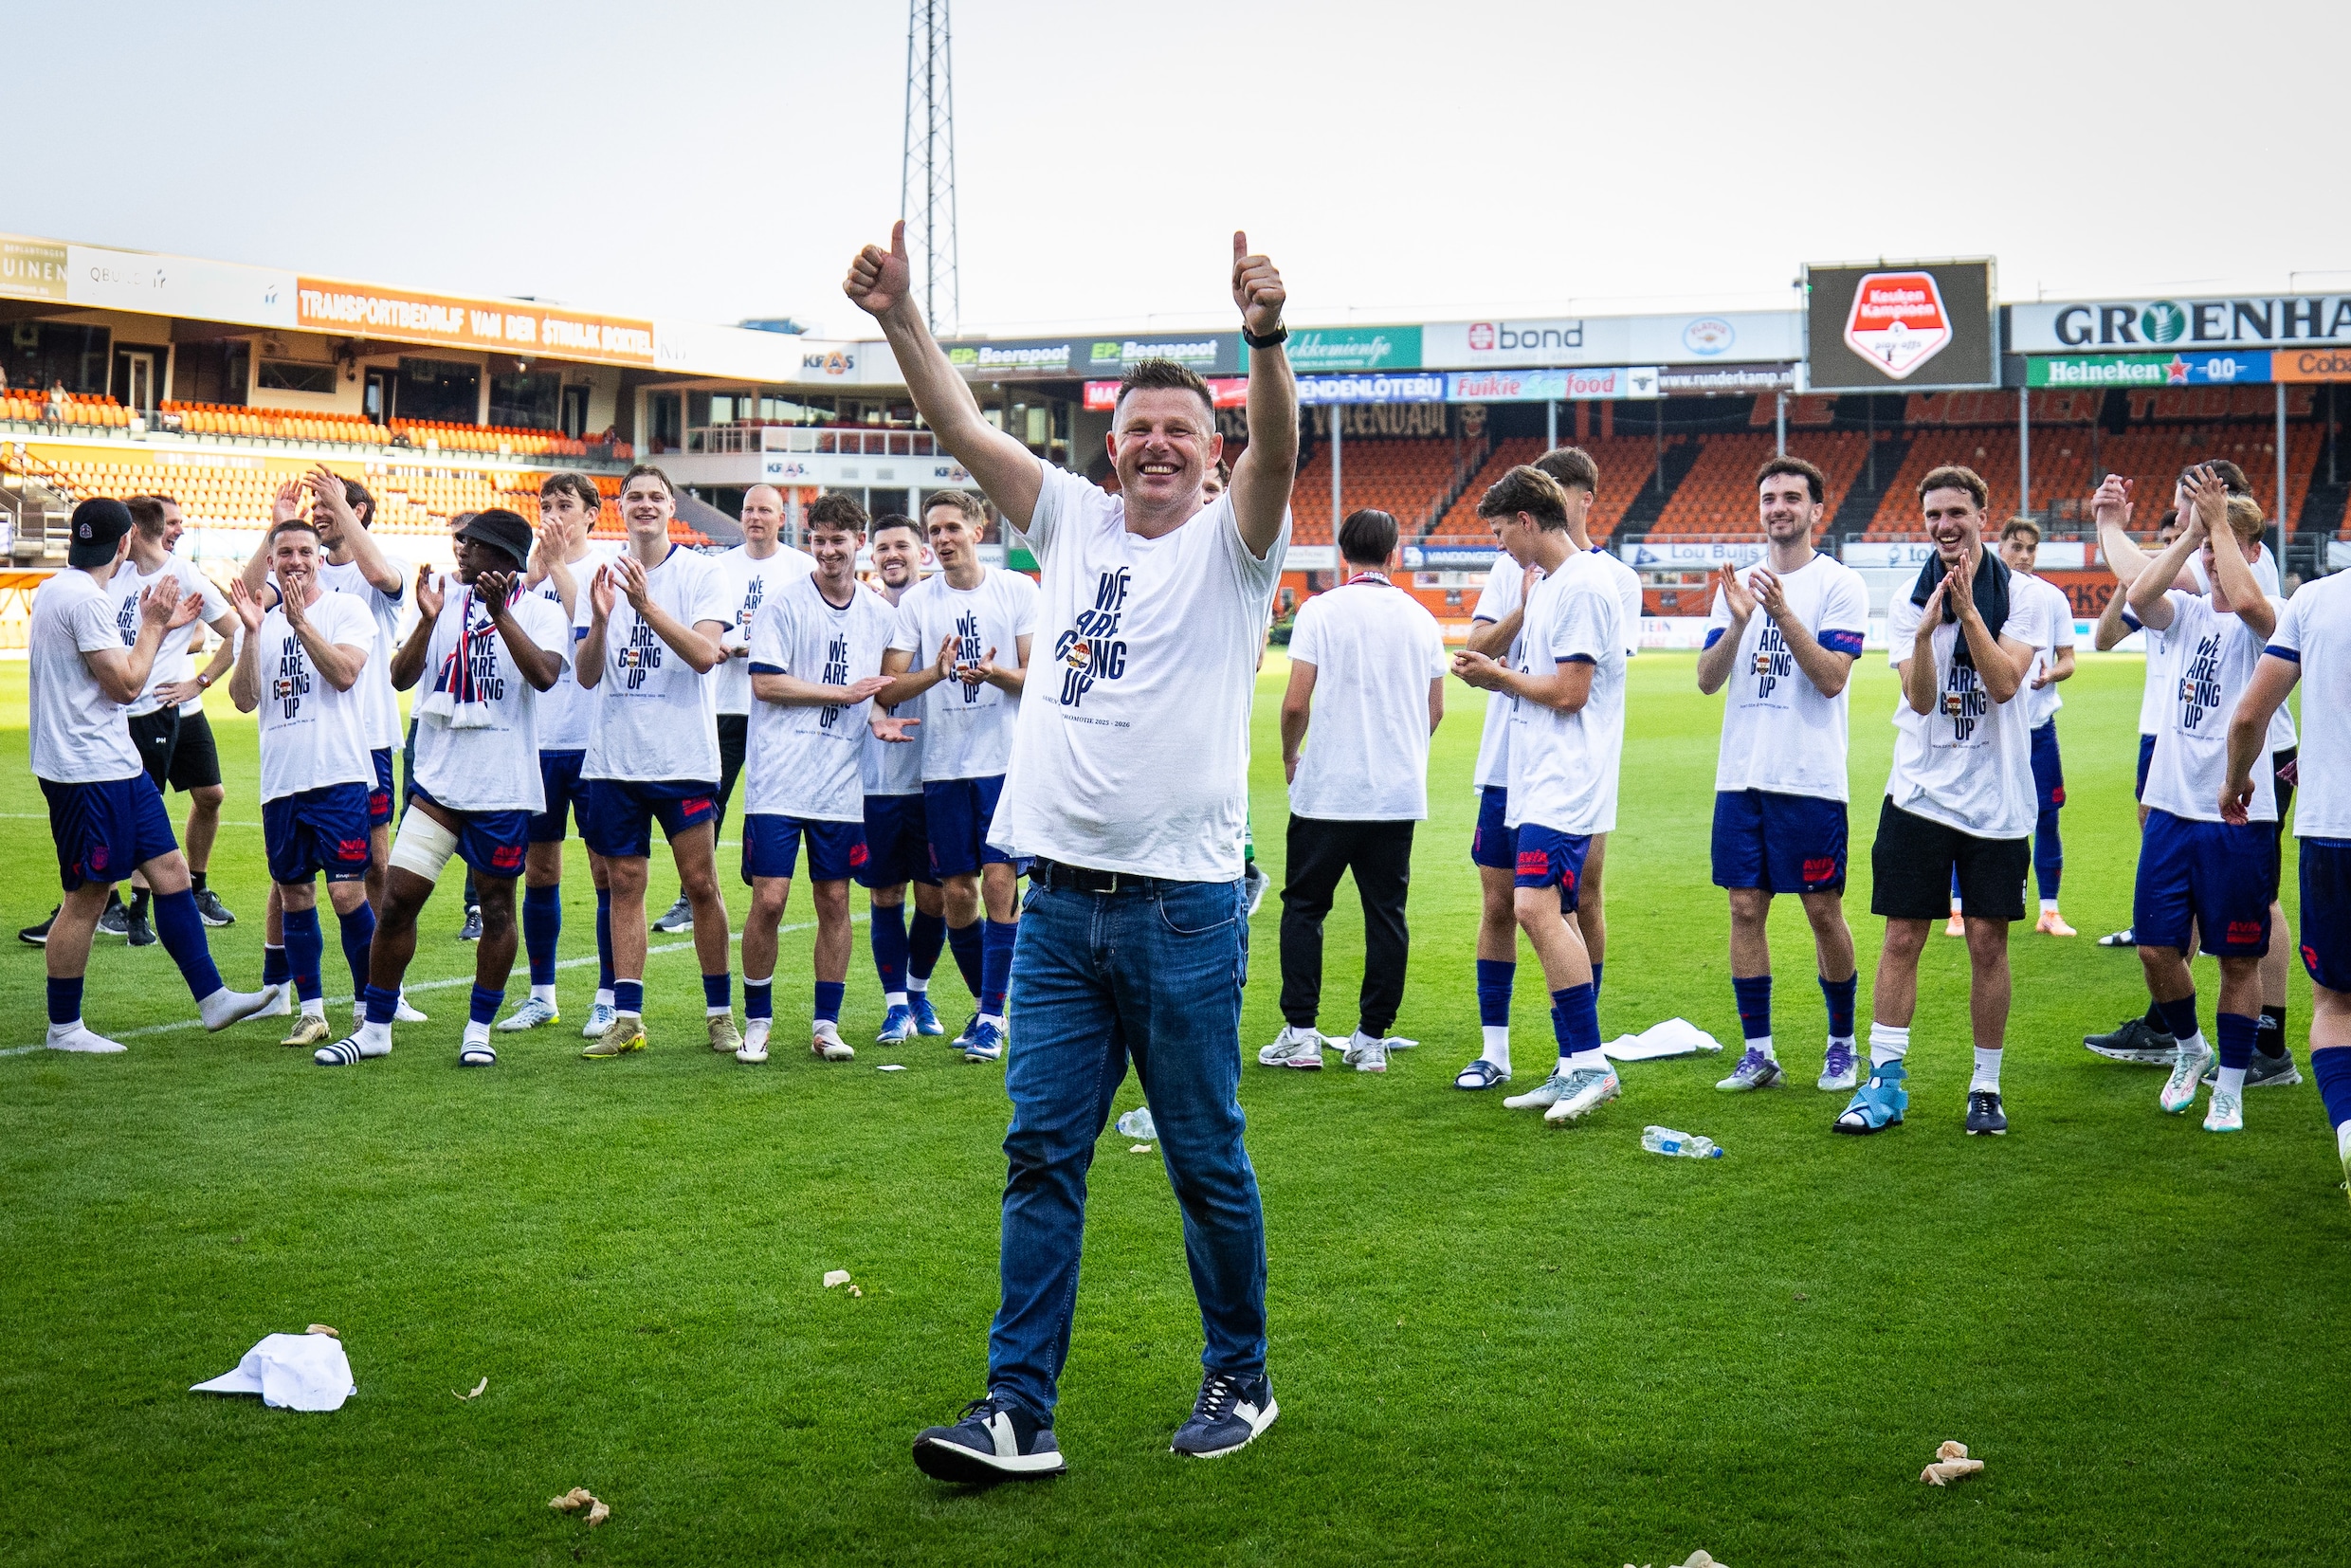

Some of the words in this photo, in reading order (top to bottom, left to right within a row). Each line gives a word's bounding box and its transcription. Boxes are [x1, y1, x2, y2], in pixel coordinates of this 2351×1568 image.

[1869, 288, 1925, 303] Keuken
[1860, 303, 1936, 319] Kampioen
[470, 309, 502, 338] VAN
[505, 314, 537, 342] DER
[1499, 319, 1583, 350] bond
[978, 344, 1070, 364] Beerepoot
[1121, 339, 1218, 358] Beerepoot
[2048, 358, 2161, 381] Heineken
[1671, 544, 1704, 559] Lou
[1713, 544, 1759, 566] Buijs
[748, 574, 764, 594] WE
[1095, 567, 1131, 611] WE
[957, 610, 977, 637] WE
[1076, 610, 1121, 638] ARE
[475, 634, 496, 656] WE
[629, 626, 654, 647] ARE
[829, 632, 848, 664] WE
[2196, 632, 2220, 659] WE
[618, 647, 662, 668] GOING
[956, 637, 981, 661] ARE
[1055, 629, 1127, 680] GOING
[280, 654, 303, 678] ARE
[822, 664, 848, 685] ARE
[1751, 652, 1792, 677] GOING
[2186, 656, 2218, 683] ARE
[273, 673, 310, 701] GOING
[628, 668, 646, 690] UP
[1060, 667, 1094, 707] UP
[1759, 676, 1776, 699] UP
[1940, 690, 1987, 717] GOING
[2179, 677, 2221, 707] GOING
[283, 697, 300, 720] UP
[820, 707, 839, 729] UP
[2184, 703, 2203, 730] UP
[1955, 717, 1975, 740] UP
